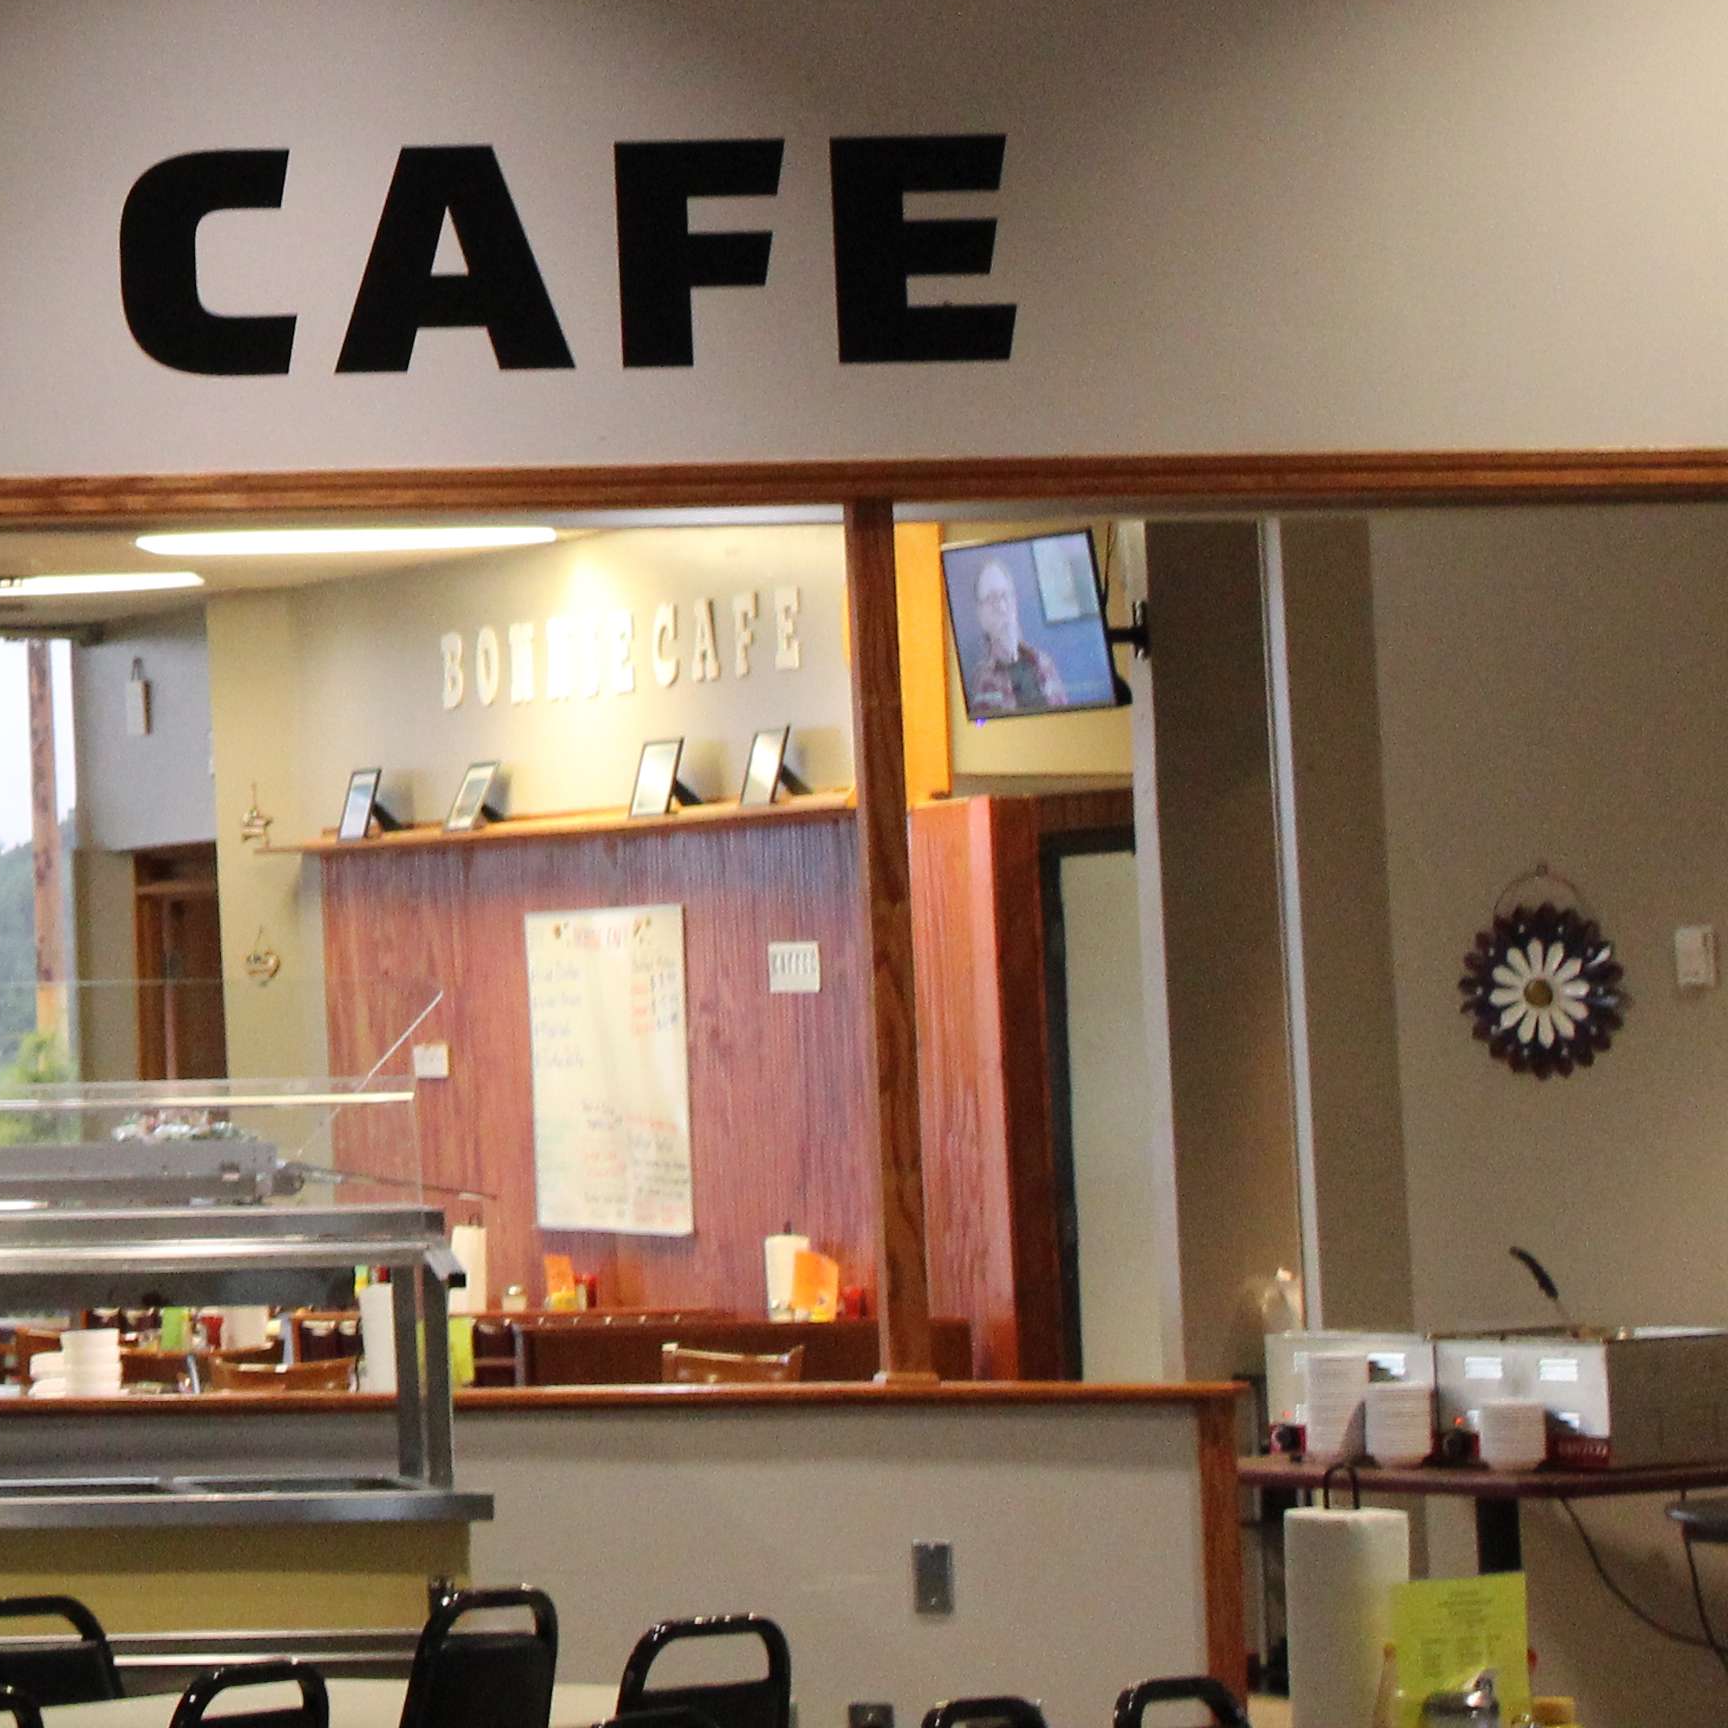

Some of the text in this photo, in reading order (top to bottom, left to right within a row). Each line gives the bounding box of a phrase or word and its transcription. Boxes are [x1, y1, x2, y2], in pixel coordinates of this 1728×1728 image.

[119, 133, 1018, 376] CAFE
[441, 586, 800, 710] BONNIE CAFE
